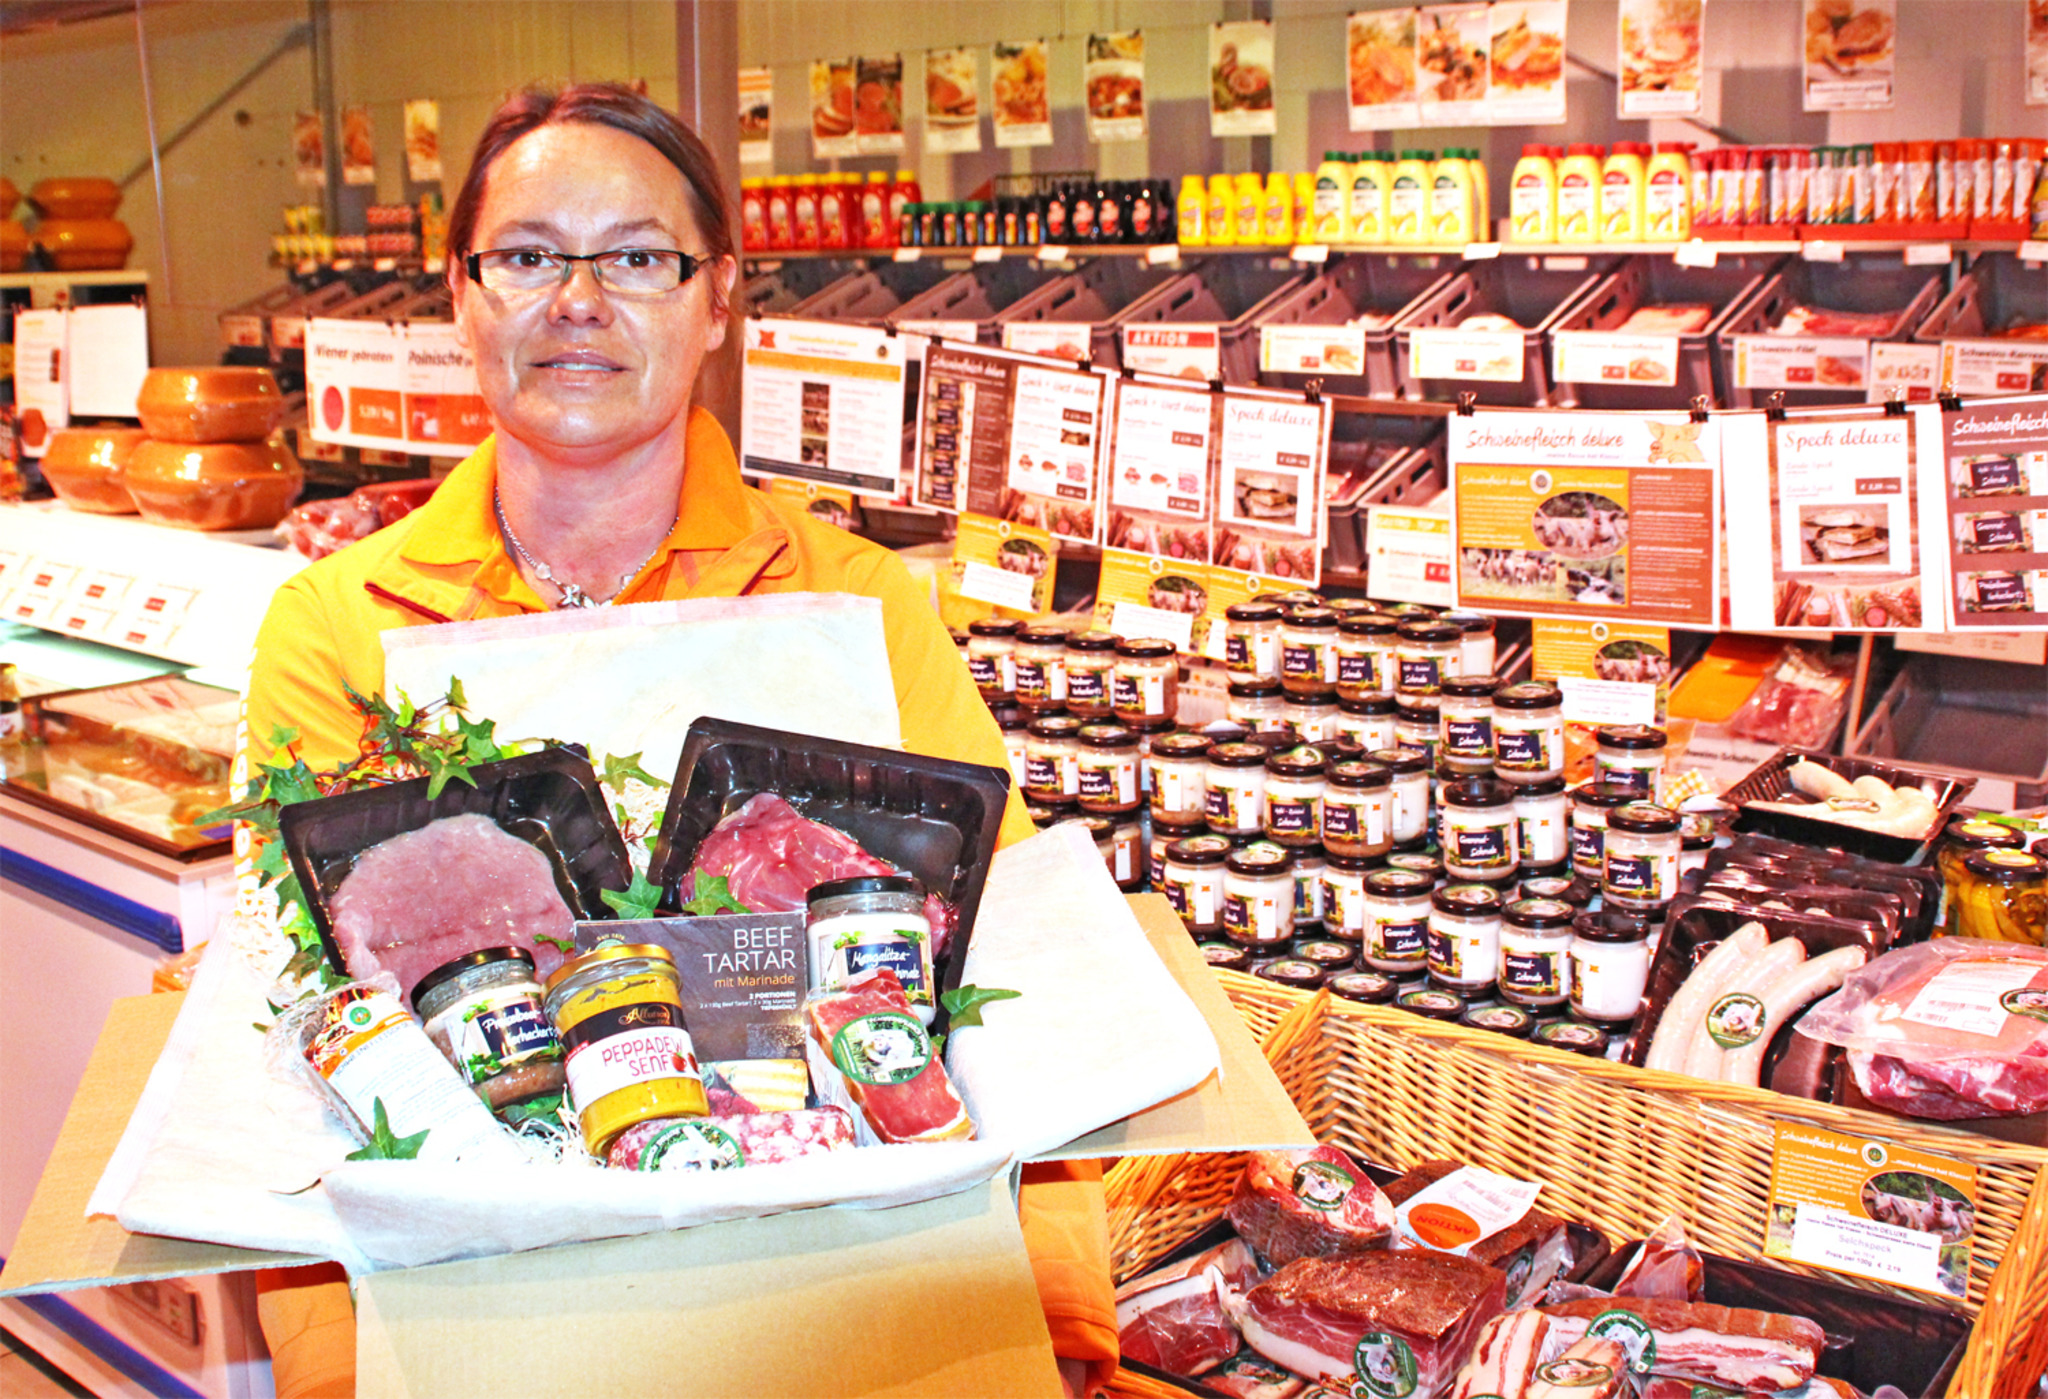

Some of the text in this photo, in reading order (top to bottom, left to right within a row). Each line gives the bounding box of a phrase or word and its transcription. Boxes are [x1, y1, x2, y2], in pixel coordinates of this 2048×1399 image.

[1228, 404, 1315, 427] Speck deluxe
[1465, 426, 1625, 453] Schweinefleisch deluxe
[1784, 427, 1902, 453] Speck deluxe
[734, 926, 793, 950] BEEF
[702, 950, 797, 974] TARTAR
[714, 973, 796, 989] mit Marinade
[754, 991, 797, 999] PORTIONEN
[601, 1036, 683, 1067] PEPPADEW
[628, 1054, 669, 1077] SENF
[1416, 1216, 1473, 1235] AKTION
[1826, 1214, 1908, 1239] Schweinefleisch DELUXE
[1825, 1250, 1842, 1259] Preis
[1838, 1235, 1892, 1254] Selchspeck
